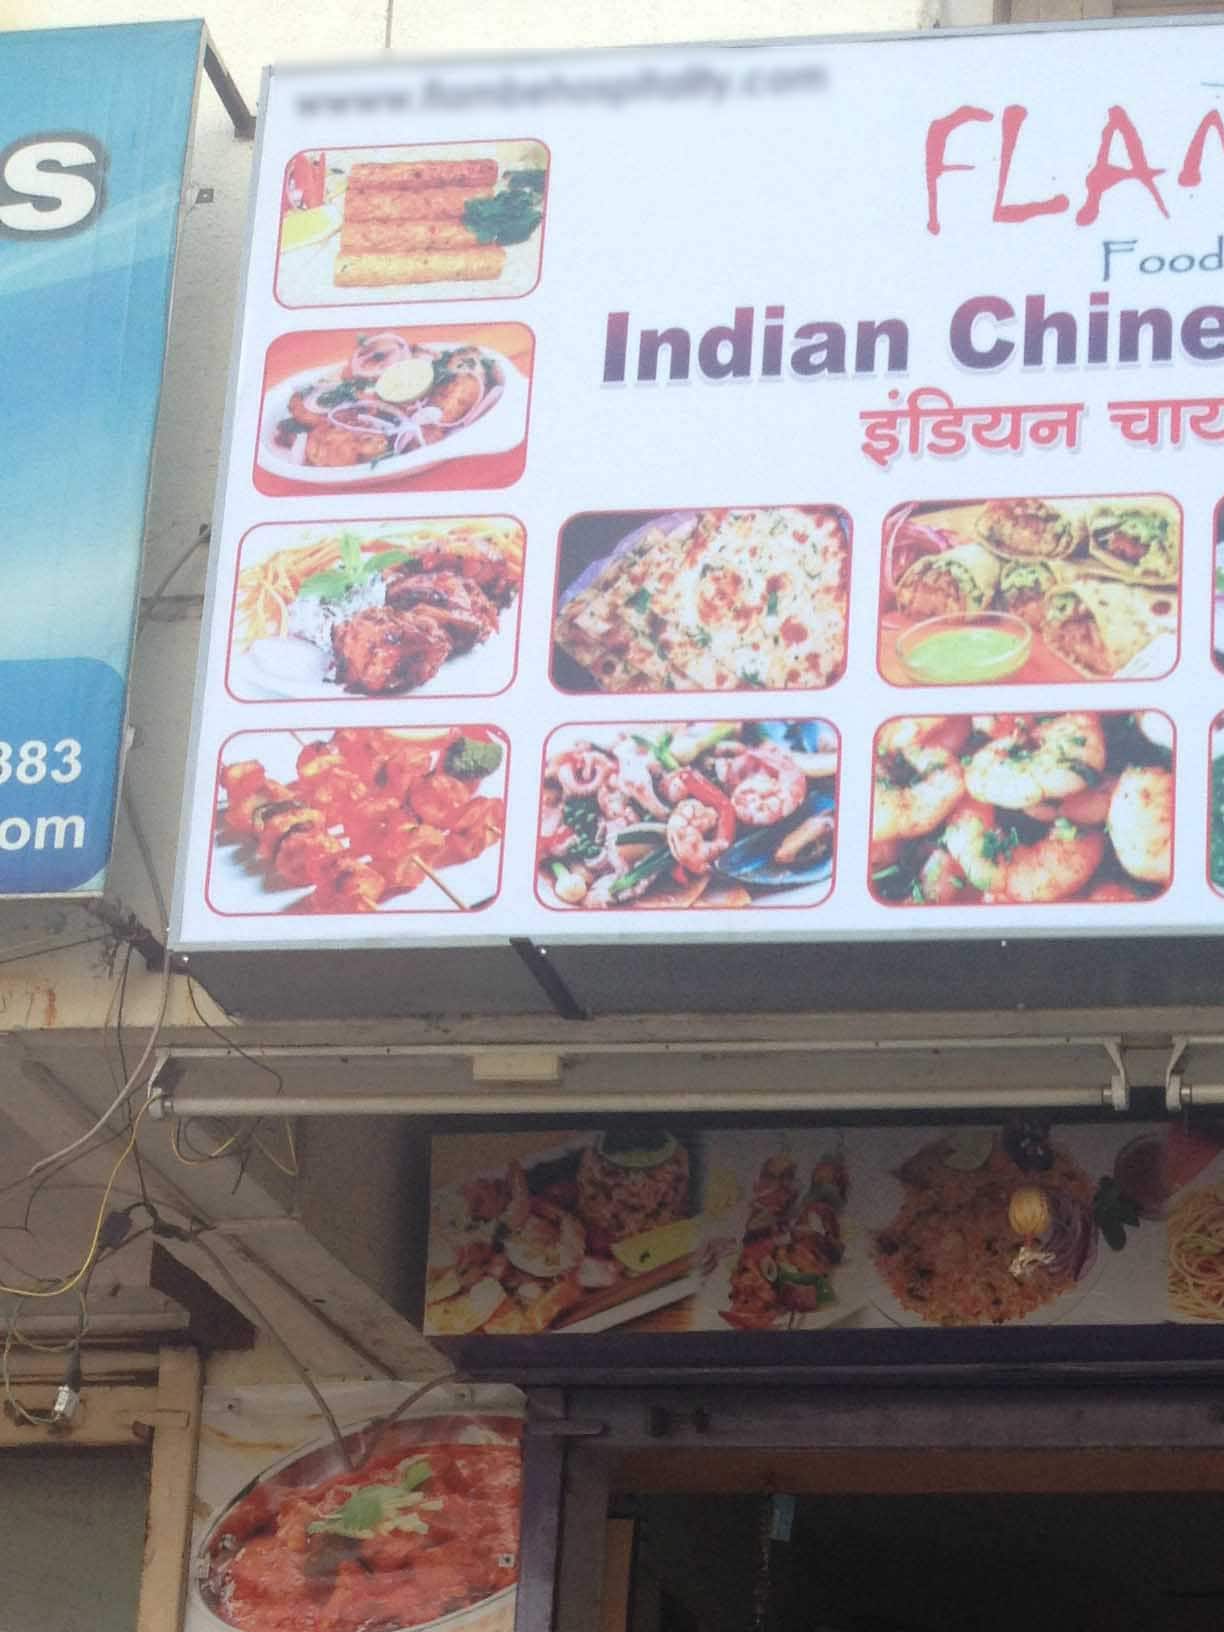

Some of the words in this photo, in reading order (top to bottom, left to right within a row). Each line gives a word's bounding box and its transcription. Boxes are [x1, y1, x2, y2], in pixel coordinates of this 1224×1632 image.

[1101, 234, 1224, 282] Food
[603, 306, 909, 382] Indian
[860, 388, 1084, 466] इंडियन
